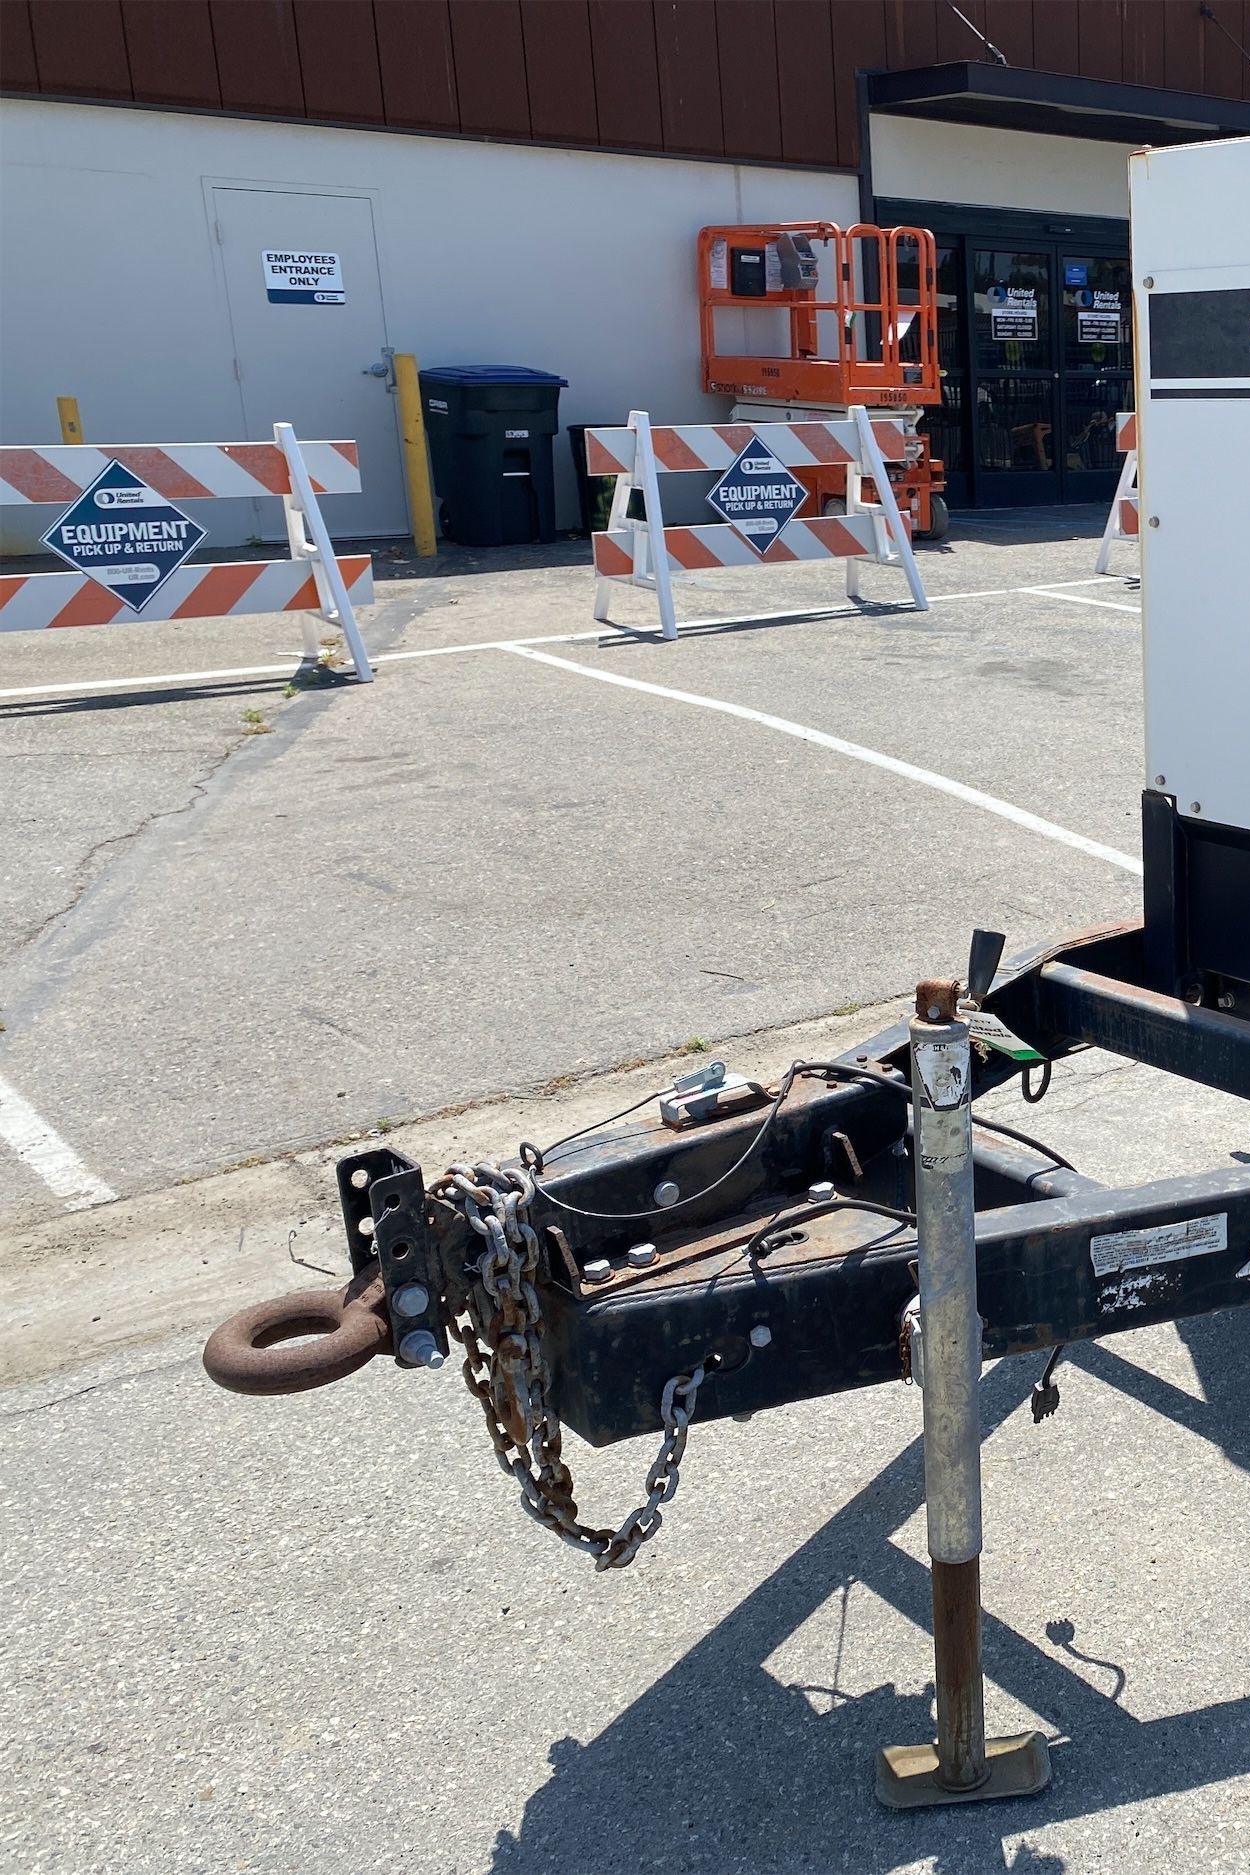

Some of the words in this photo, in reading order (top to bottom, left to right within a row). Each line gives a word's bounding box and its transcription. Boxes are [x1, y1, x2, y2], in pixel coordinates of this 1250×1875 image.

[266, 253, 336, 265] EMPLOYEES
[271, 265, 335, 276] ENTRANCE
[289, 277, 320, 286] ONLY
[1007, 287, 1035, 298] United
[1093, 291, 1119, 301] United
[1007, 297, 1037, 307] Rentals
[1093, 300, 1121, 310] Rentals
[719, 484, 798, 502] EQUIPMENT
[725, 501, 744, 512] PICK
[745, 502, 755, 511] UP
[756, 501, 763, 510] &
[764, 499, 794, 509] RETURN
[60, 520, 190, 546] EQUIPMENT
[72, 544, 104, 557] PICK
[104, 543, 122, 555] UP
[123, 542, 135, 554] &
[136, 540, 184, 553] RETURN
